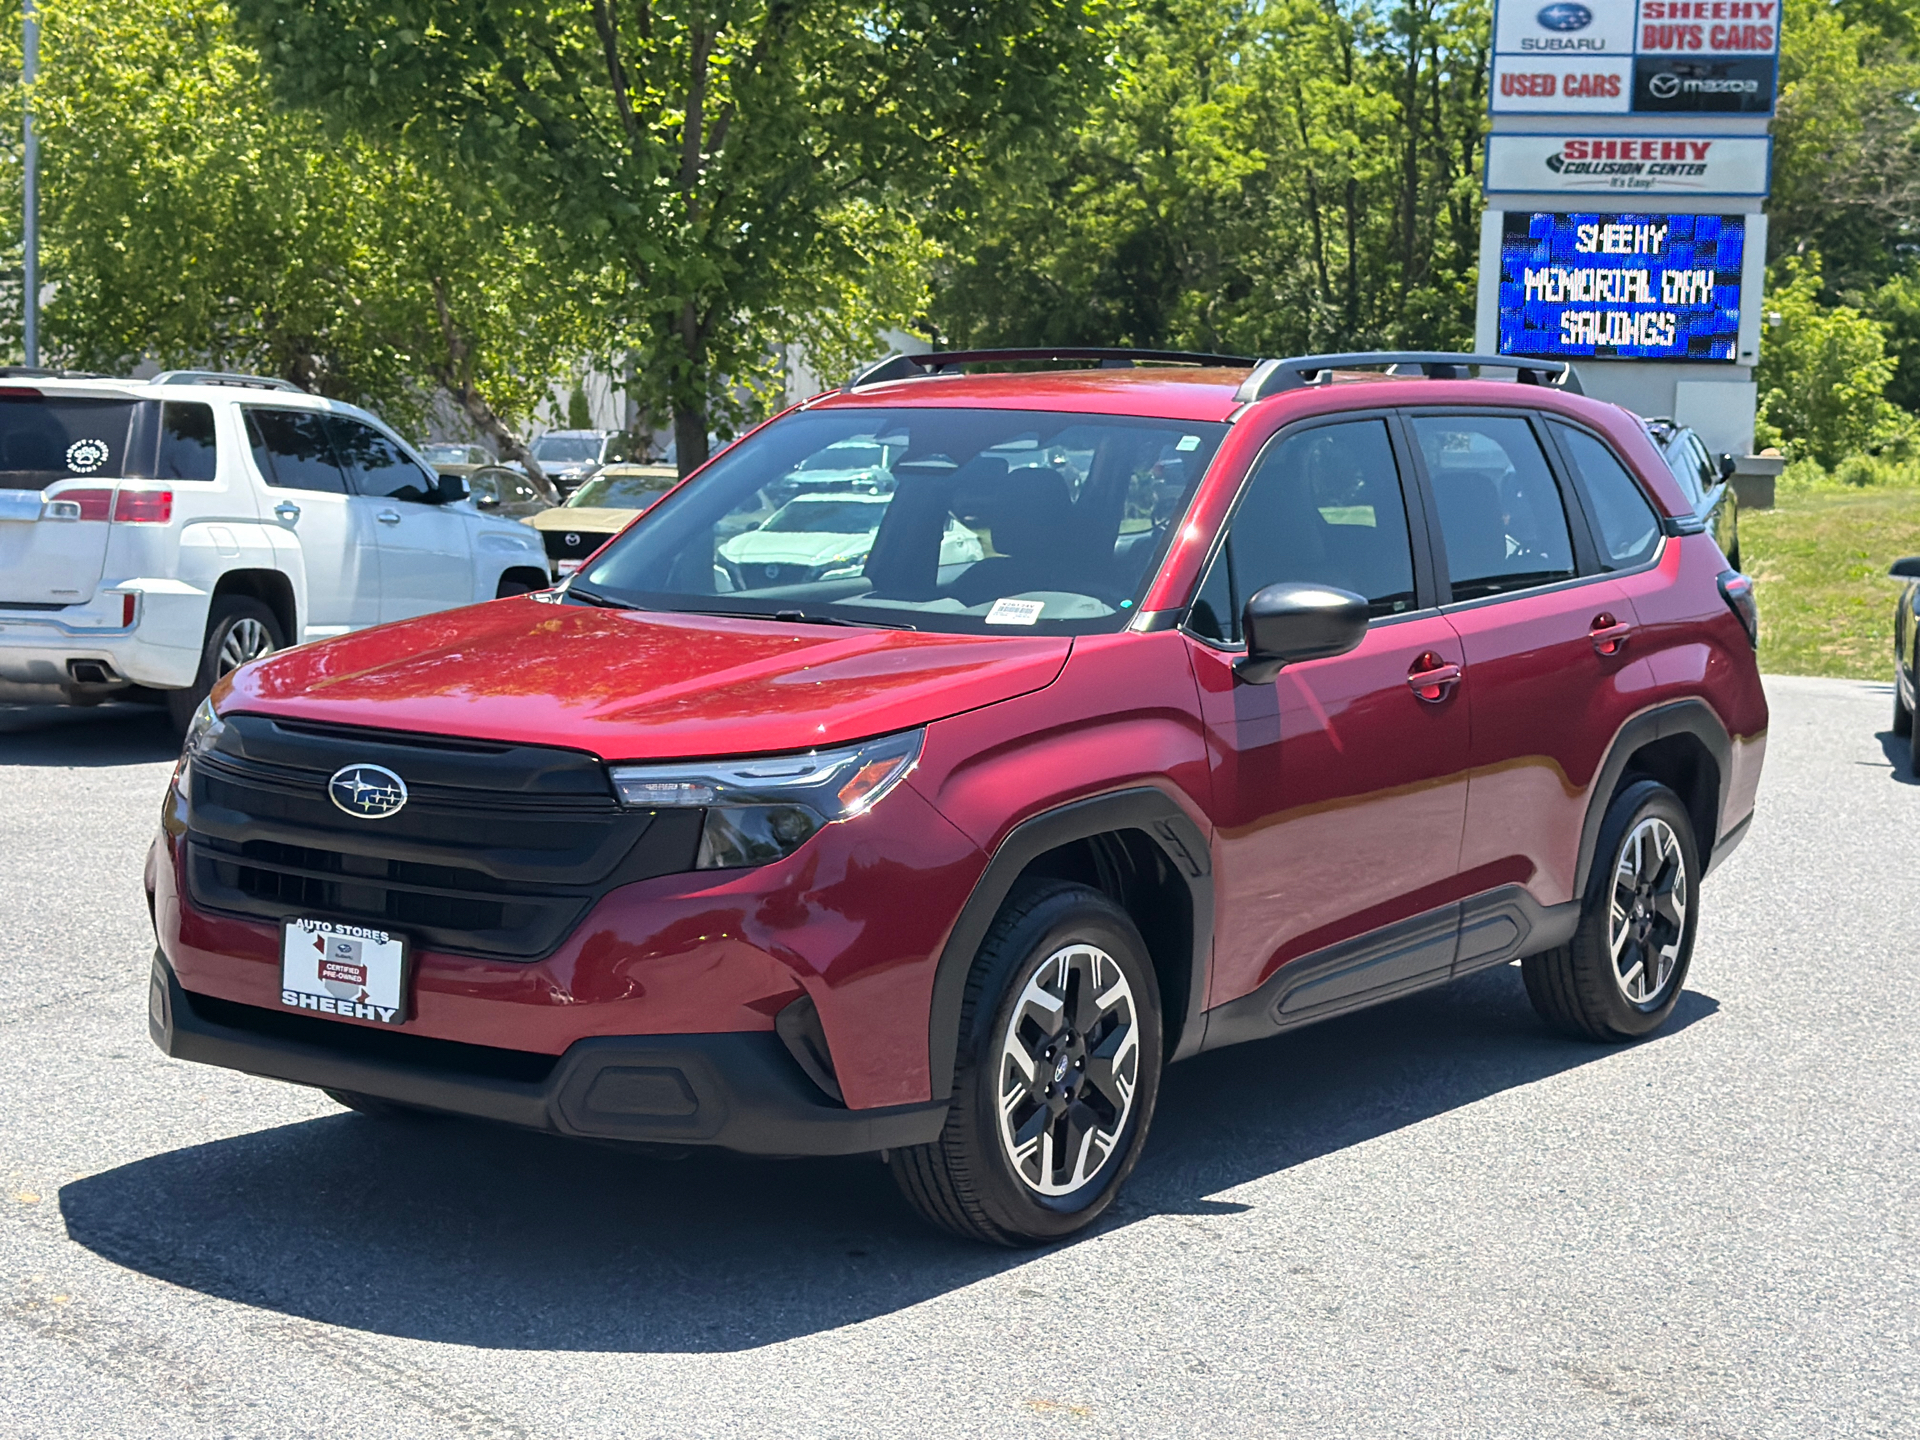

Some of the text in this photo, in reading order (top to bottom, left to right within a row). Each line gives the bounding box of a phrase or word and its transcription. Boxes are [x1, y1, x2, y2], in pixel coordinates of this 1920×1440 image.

[1642, 2, 1775, 20] SHEEHY
[1521, 38, 1606, 51] SUBARU
[1642, 24, 1774, 51] BUYS CARS
[1500, 73, 1621, 98] USED CARS
[1683, 79, 1759, 93] mazda
[1564, 140, 1713, 161] SHEEHY
[1563, 162, 1708, 176] COLLISION CENTER
[1575, 223, 1668, 255] SHEEHY
[1524, 267, 1715, 304] MEMORIAL DAY
[1560, 309, 1677, 346] SAVINGS
[295, 918, 389, 942] AUTO STORES
[322, 970, 363, 983] PRE-OWNED
[326, 963, 360, 975] CERTIFIED
[282, 991, 395, 1022] SHEEHY
